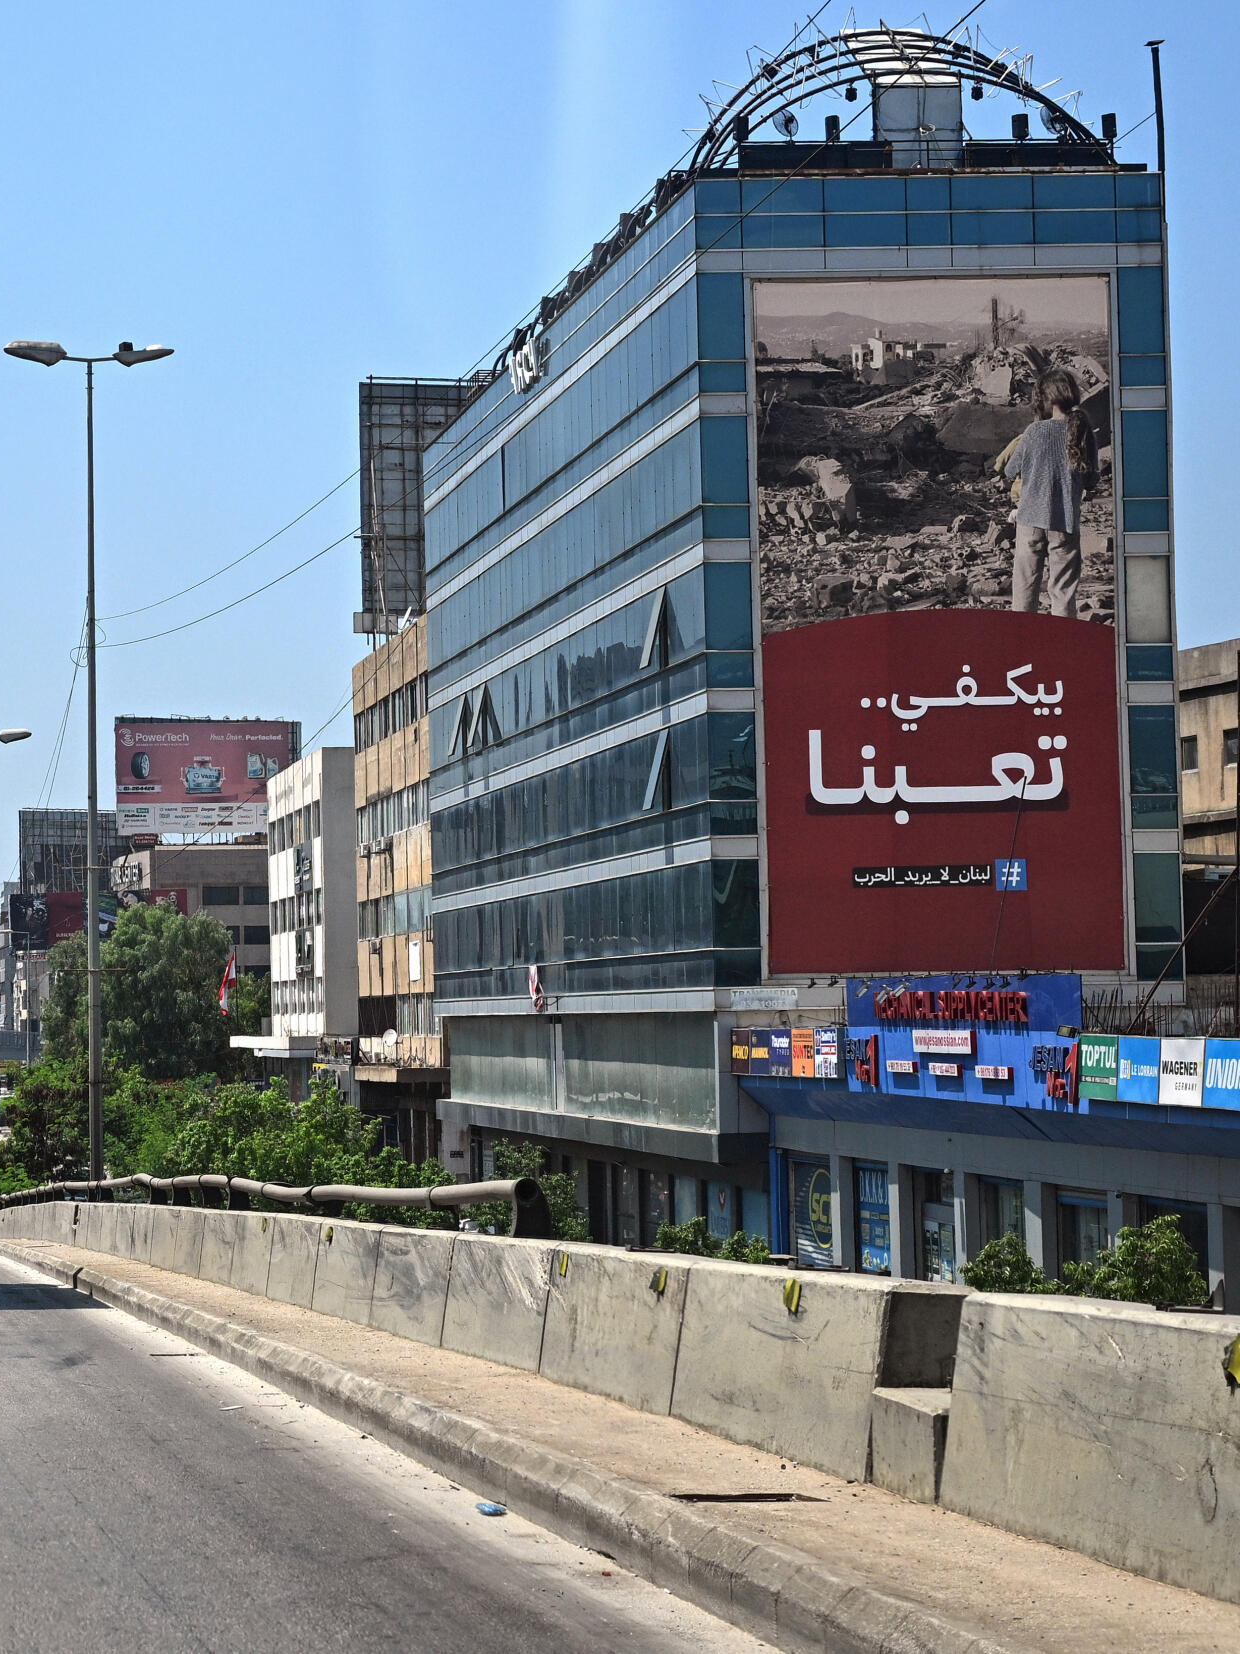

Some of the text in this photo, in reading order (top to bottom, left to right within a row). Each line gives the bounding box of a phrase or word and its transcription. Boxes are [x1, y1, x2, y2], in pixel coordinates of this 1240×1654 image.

[135, 732, 189, 742] PowerTech
[808, 729, 1067, 825] تعبنا
[937, 991, 978, 1020] SUPPLY
[979, 991, 1028, 1022] CENTER
[793, 1044, 814, 1059] SUNTEC
[1028, 1045, 1065, 1072] JESAN
[1081, 1044, 1116, 1069] TOPTUL
[1161, 1060, 1198, 1077] WAGENER
[1174, 1082, 1197, 1091] GERMANY
